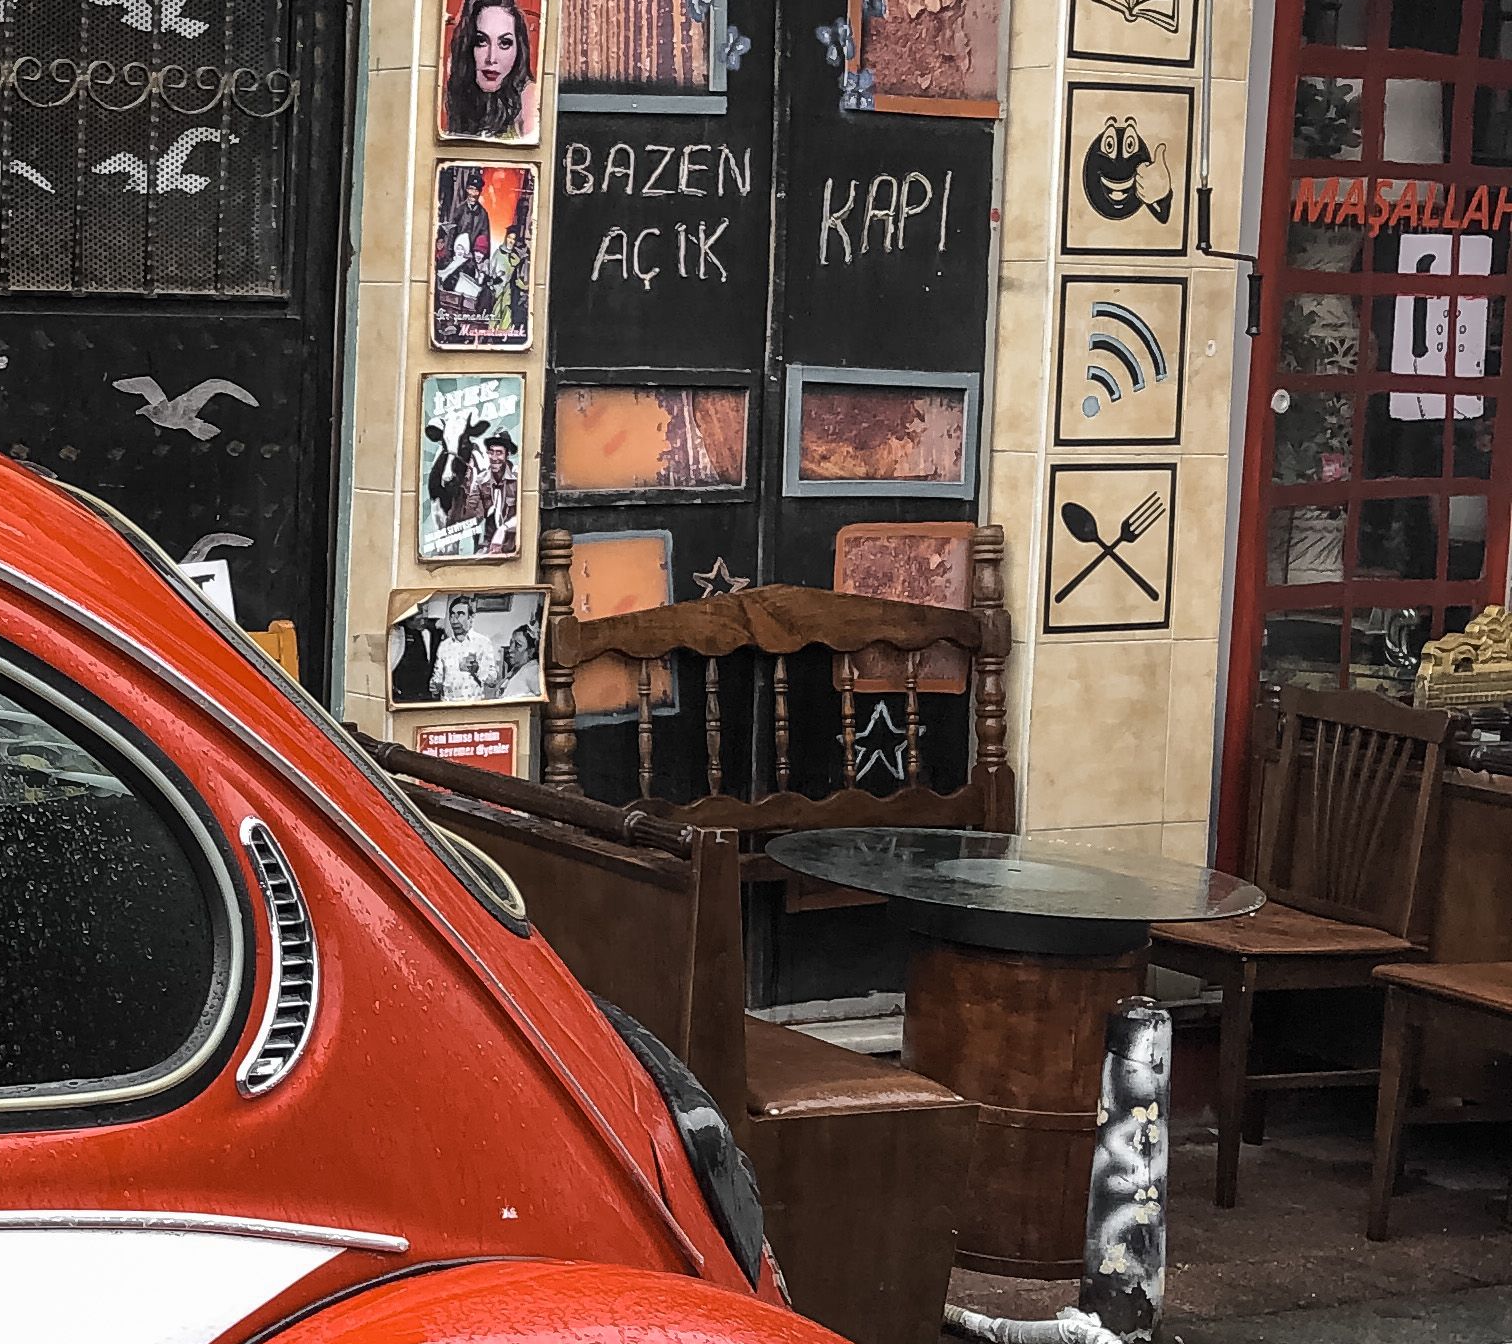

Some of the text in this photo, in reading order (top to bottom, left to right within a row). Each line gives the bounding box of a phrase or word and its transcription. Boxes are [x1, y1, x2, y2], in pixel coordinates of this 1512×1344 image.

[562, 143, 752, 197] BAZEN
[590, 217, 730, 291] AÇIK
[819, 170, 953, 265] KAPI
